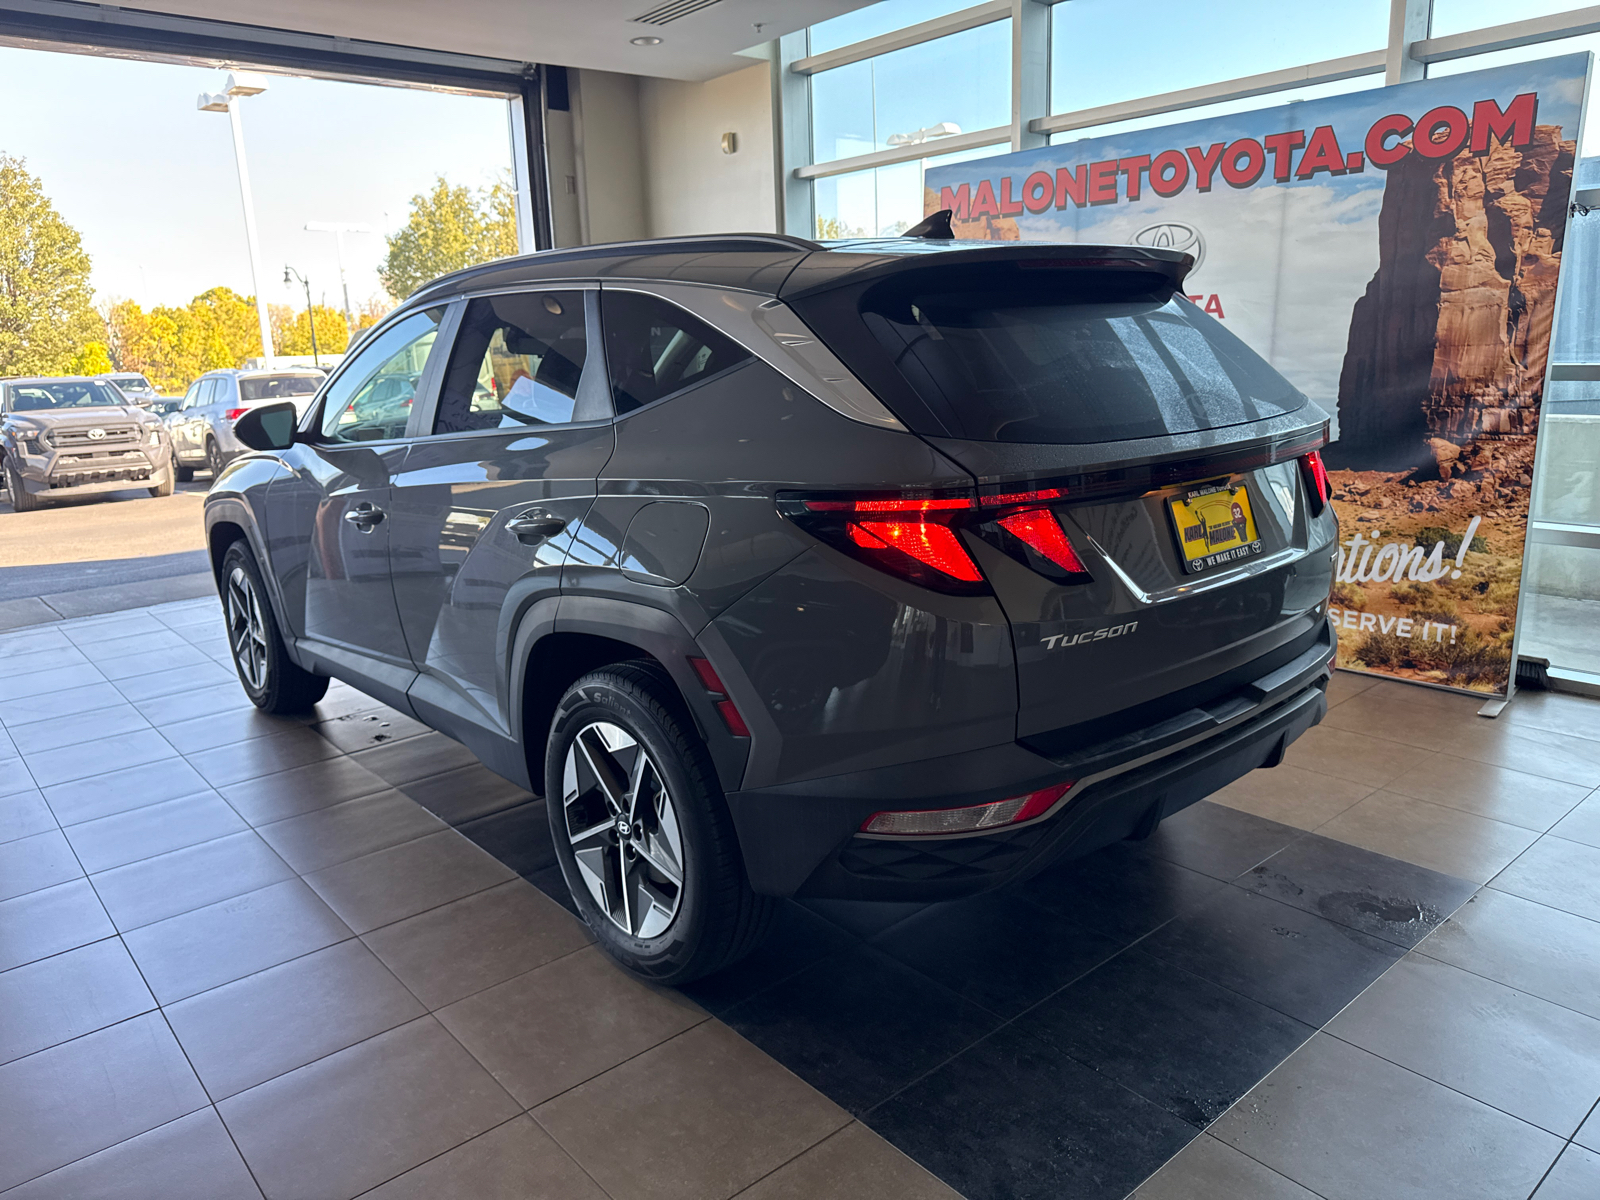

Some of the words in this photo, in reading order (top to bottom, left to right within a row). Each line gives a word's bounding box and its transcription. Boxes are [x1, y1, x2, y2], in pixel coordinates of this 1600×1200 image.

[940, 91, 1539, 224] MALONETOYOTA.COM
[1232, 507, 1242, 519] 32
[1184, 523, 1205, 543] KARL
[1209, 525, 1237, 546] MALONE
[1206, 556, 1217, 566] WE
[1215, 551, 1231, 563] MAKE
[1230, 549, 1237, 559] IT
[1236, 546, 1250, 558] EASY
[1422, 620, 1458, 645] IT!
